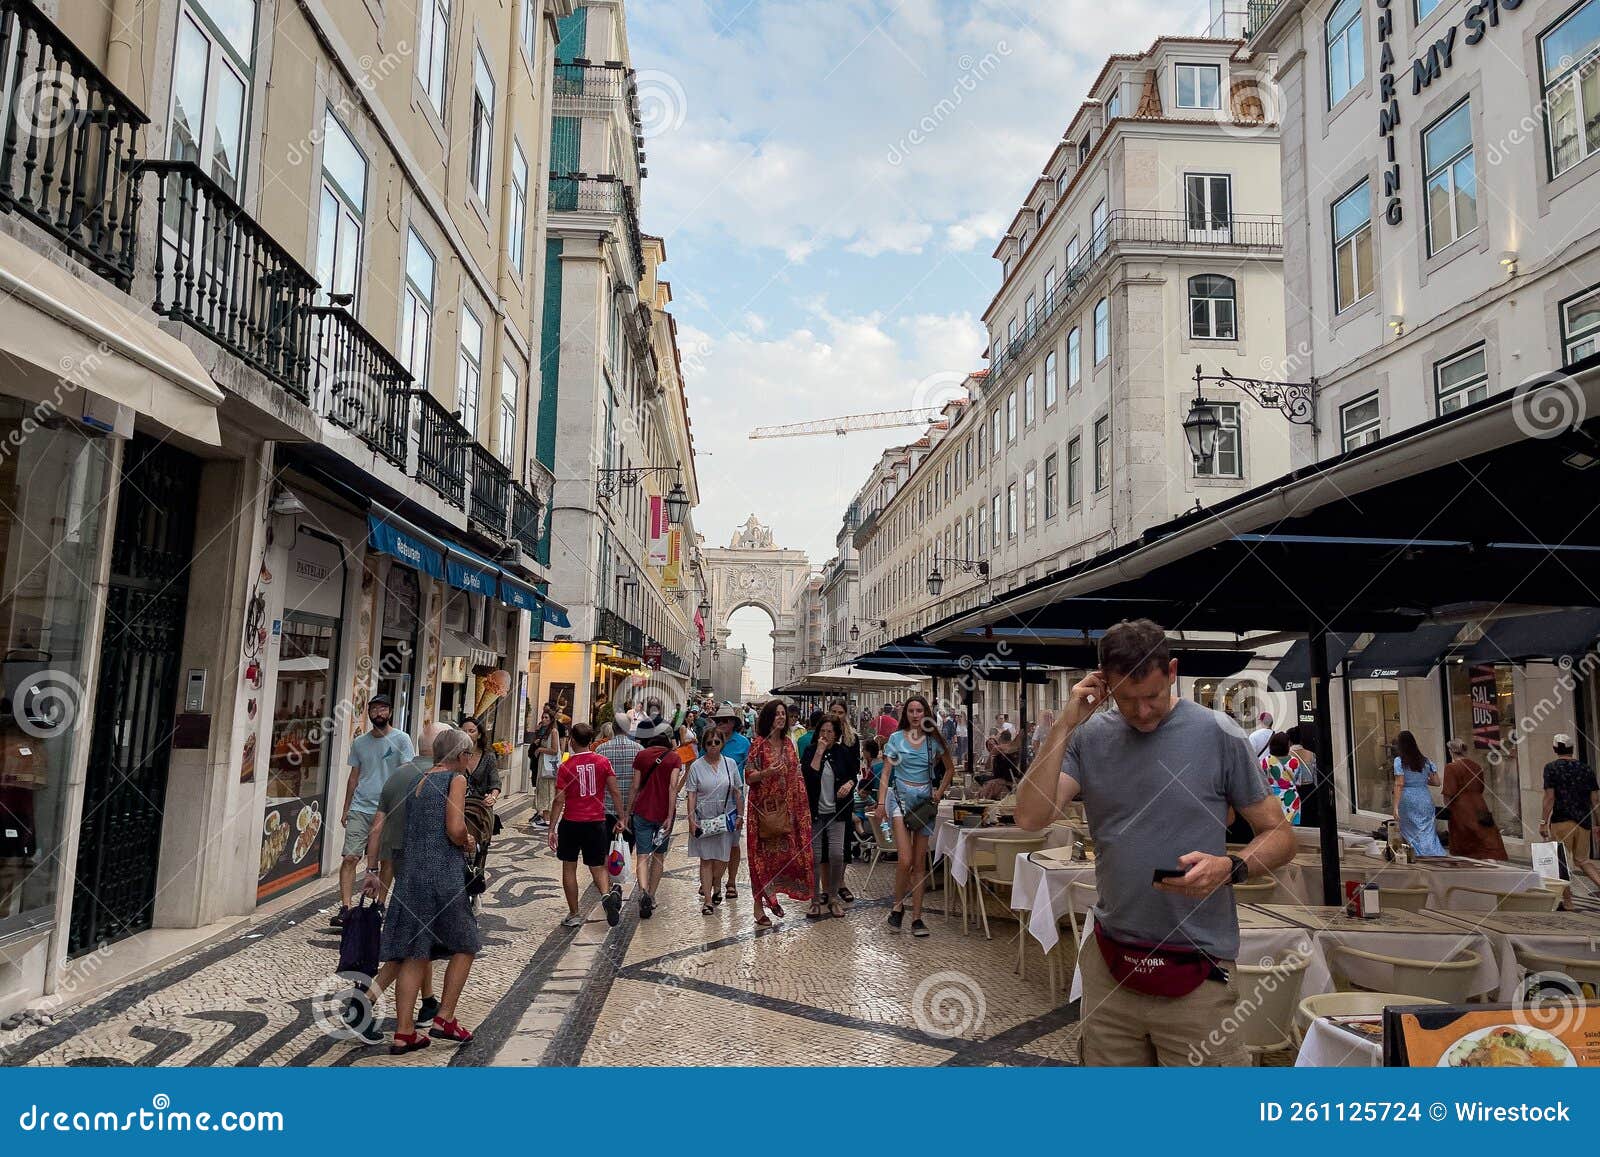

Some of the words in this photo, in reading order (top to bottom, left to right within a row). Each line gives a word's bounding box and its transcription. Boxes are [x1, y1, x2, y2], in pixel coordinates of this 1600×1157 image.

[1412, 26, 1457, 96] MY
[576, 764, 597, 797] 11
[1140, 958, 1166, 967] YORK
